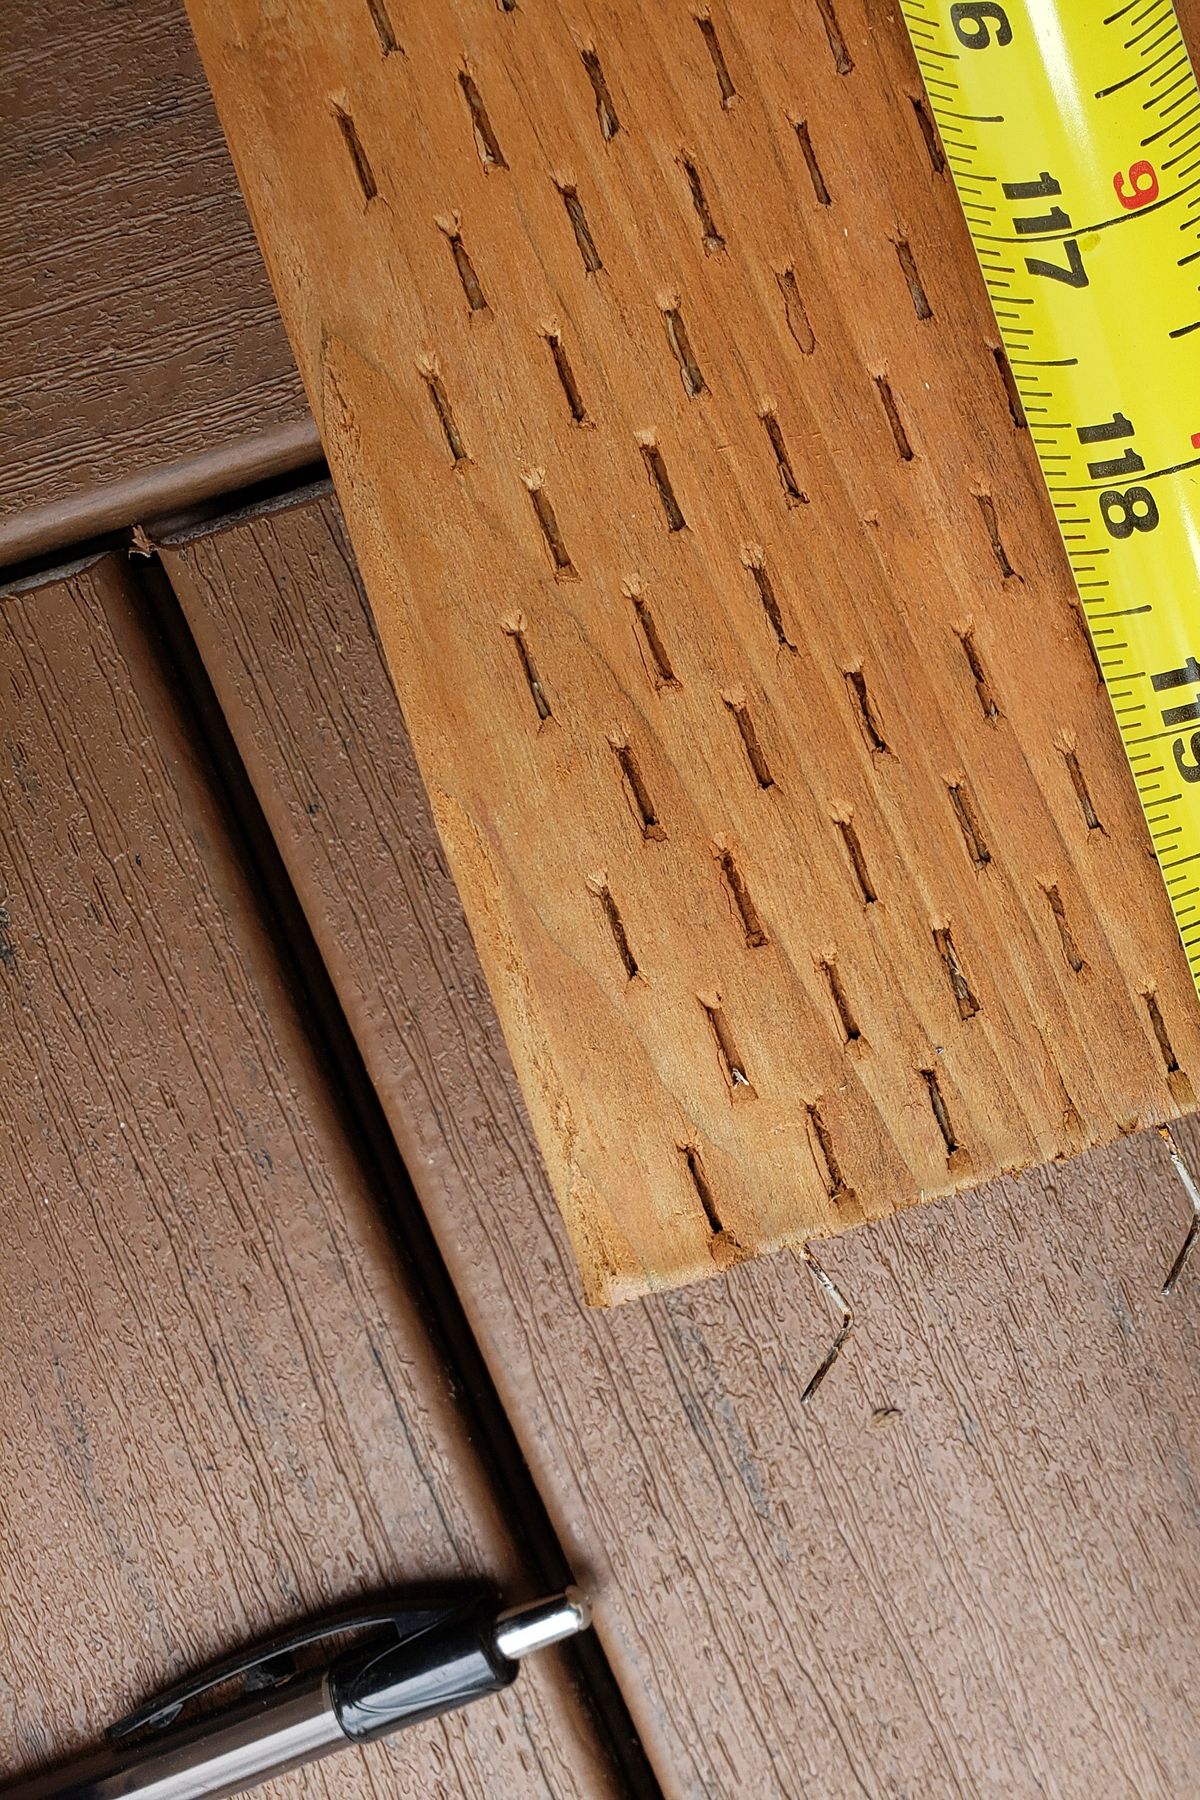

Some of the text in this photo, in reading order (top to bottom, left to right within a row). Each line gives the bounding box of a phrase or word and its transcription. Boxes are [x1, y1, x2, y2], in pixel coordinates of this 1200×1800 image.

[1001, 171, 1090, 289] 117
[1112, 159, 1159, 210] 9
[1076, 412, 1160, 540] 118
